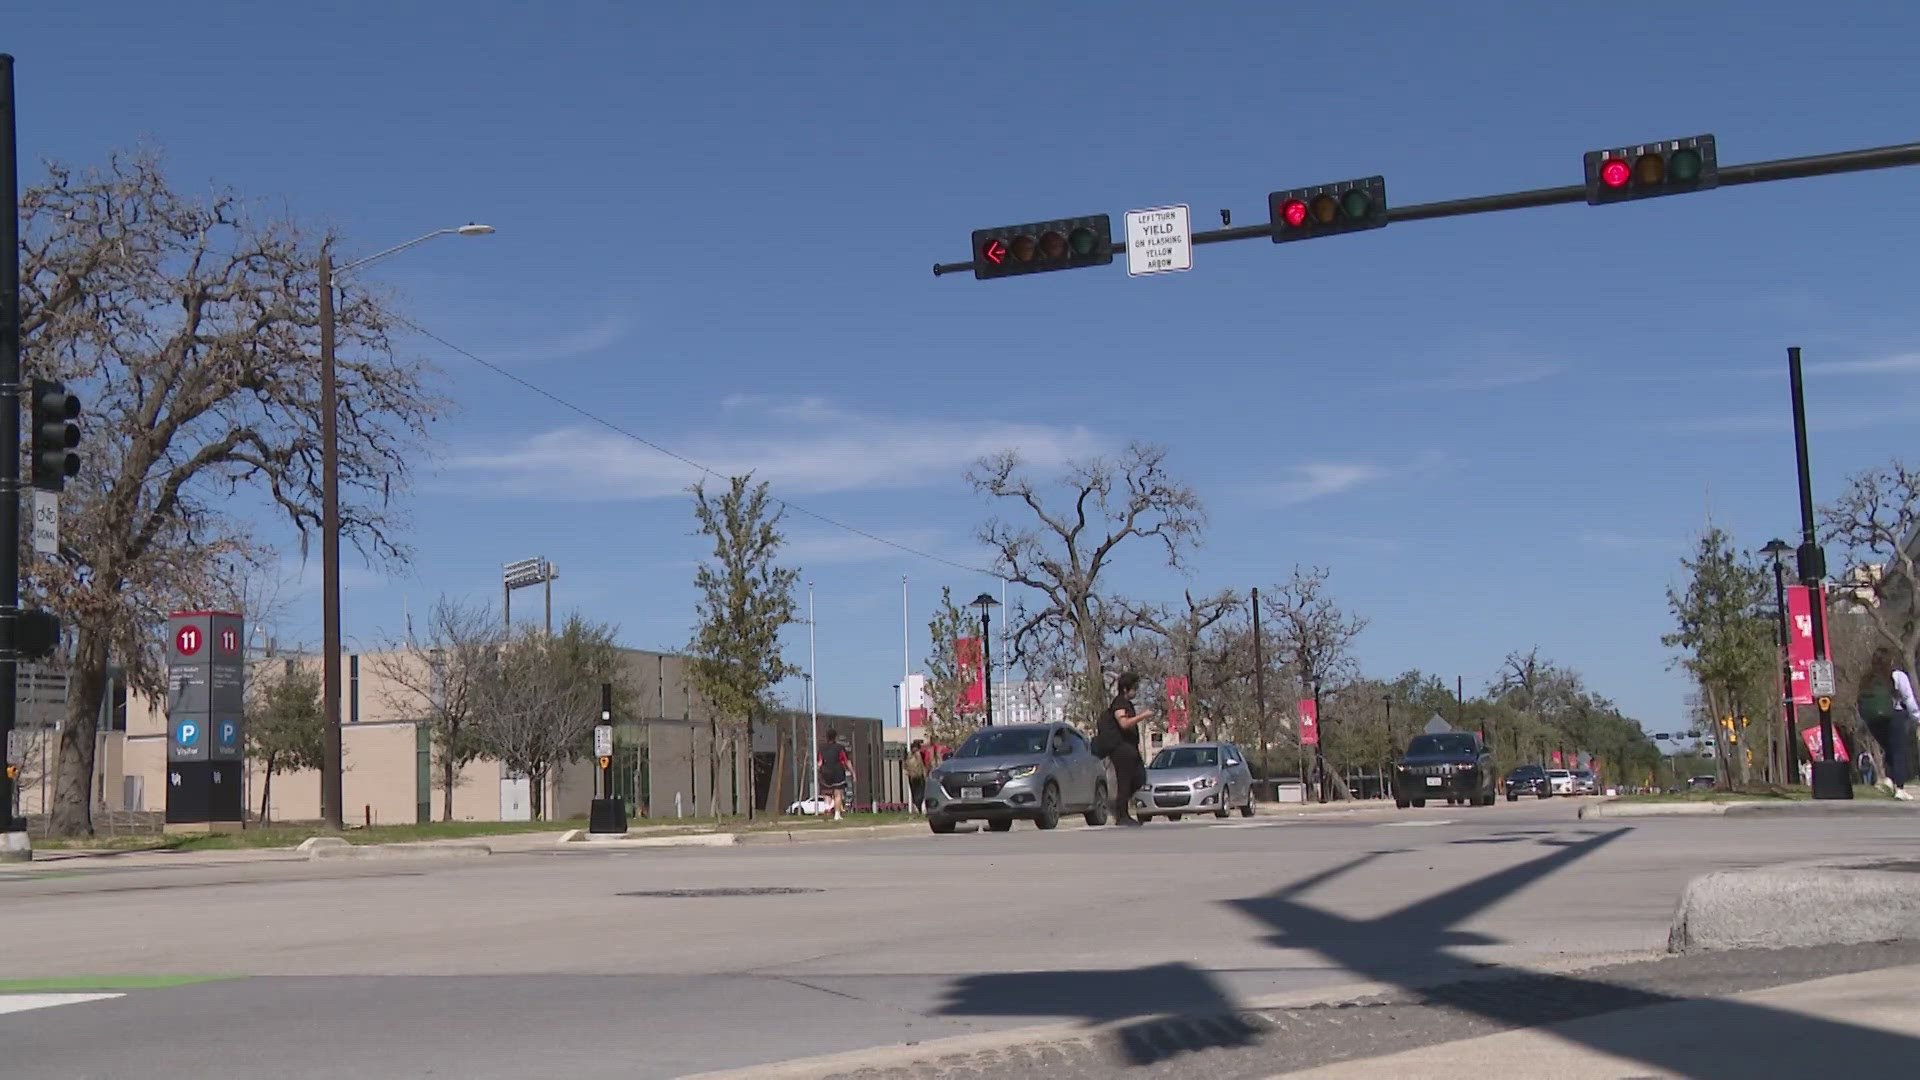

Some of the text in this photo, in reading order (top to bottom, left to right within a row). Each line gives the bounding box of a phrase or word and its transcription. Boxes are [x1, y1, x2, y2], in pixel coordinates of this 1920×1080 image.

[1138, 212, 1175, 223] LEFT TURN
[1143, 223, 1173, 235] YIELD
[1135, 235, 1182, 248] ON FLASHING
[1146, 248, 1172, 258] YELLOW
[1148, 259, 1172, 268] ARROW
[36, 528, 55, 540] SIGNAL
[181, 631, 196, 650] 11
[222, 631, 234, 650] 11
[182, 725, 195, 742] P
[223, 724, 233, 741] P
